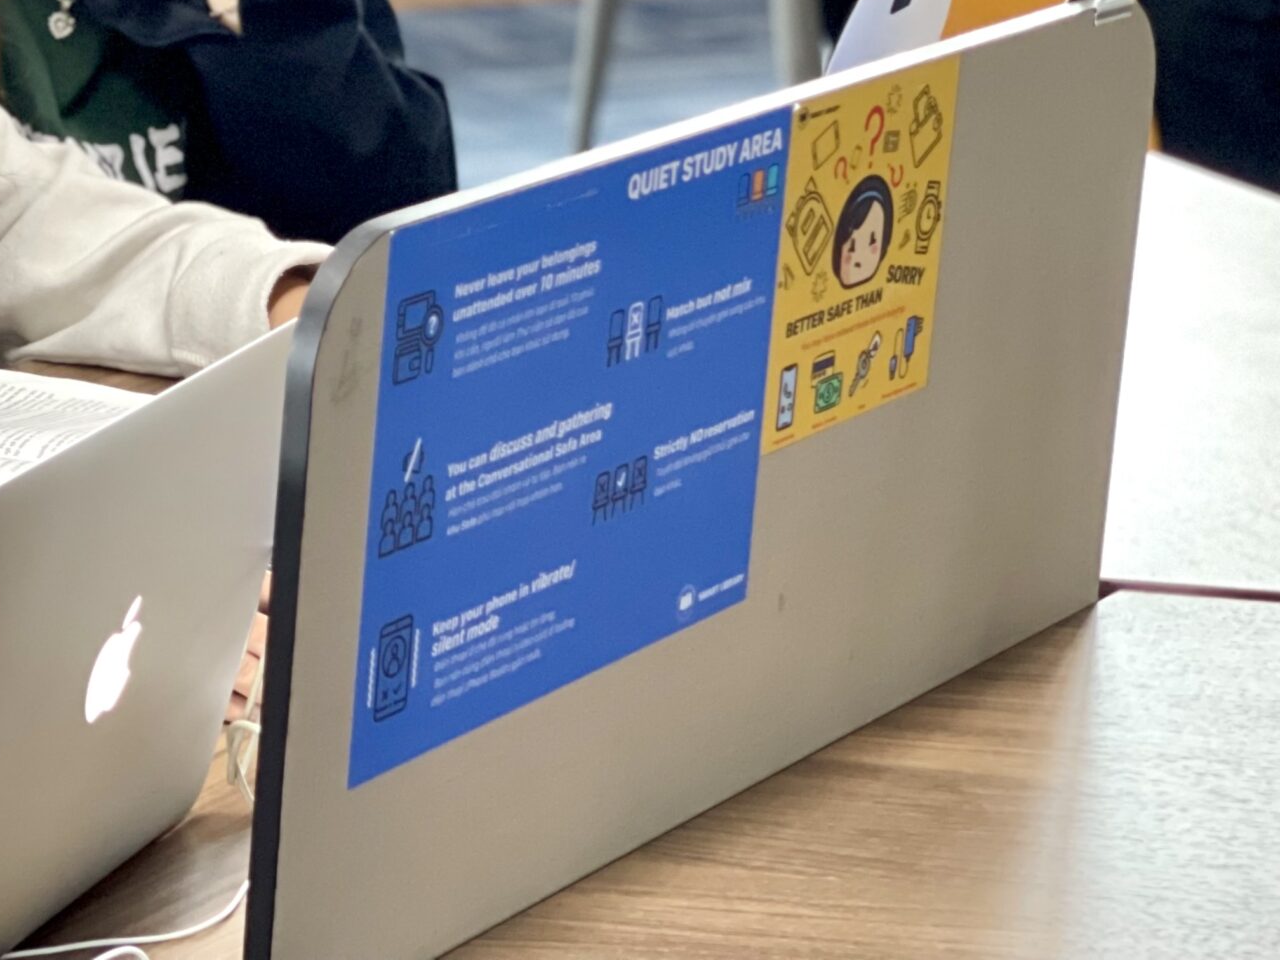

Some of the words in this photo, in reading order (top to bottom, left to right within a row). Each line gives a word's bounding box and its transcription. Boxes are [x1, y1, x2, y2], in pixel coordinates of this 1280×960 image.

[627, 161, 680, 200] QUIET
[682, 142, 738, 182] STUDY
[739, 128, 783, 164] AREA
[453, 289, 514, 322] unattended
[515, 283, 538, 300] over
[541, 273, 553, 291] 10
[554, 259, 602, 287] minutes
[455, 278, 486, 298] Never
[487, 268, 515, 287] leave
[516, 260, 540, 281] your
[541, 241, 598, 269] belongings
[886, 264, 926, 286] SORRY
[785, 310, 826, 339] BETTER
[827, 299, 855, 322] SAFE
[855, 287, 884, 312] THAN
[447, 461, 467, 477] You
[468, 453, 487, 469] can
[489, 433, 534, 461] discuss
[535, 420, 557, 443] and
[557, 402, 613, 438] gathering
[703, 409, 755, 440] reservation
[445, 485, 456, 502] at
[459, 478, 476, 496] the
[477, 445, 554, 487] Conversational
[579, 429, 602, 447] Area
[431, 629, 465, 657] silent
[467, 614, 500, 641] mode
[432, 616, 459, 637] Keep
[460, 604, 484, 627] your
[485, 589, 518, 615] phone
[519, 583, 530, 599] in
